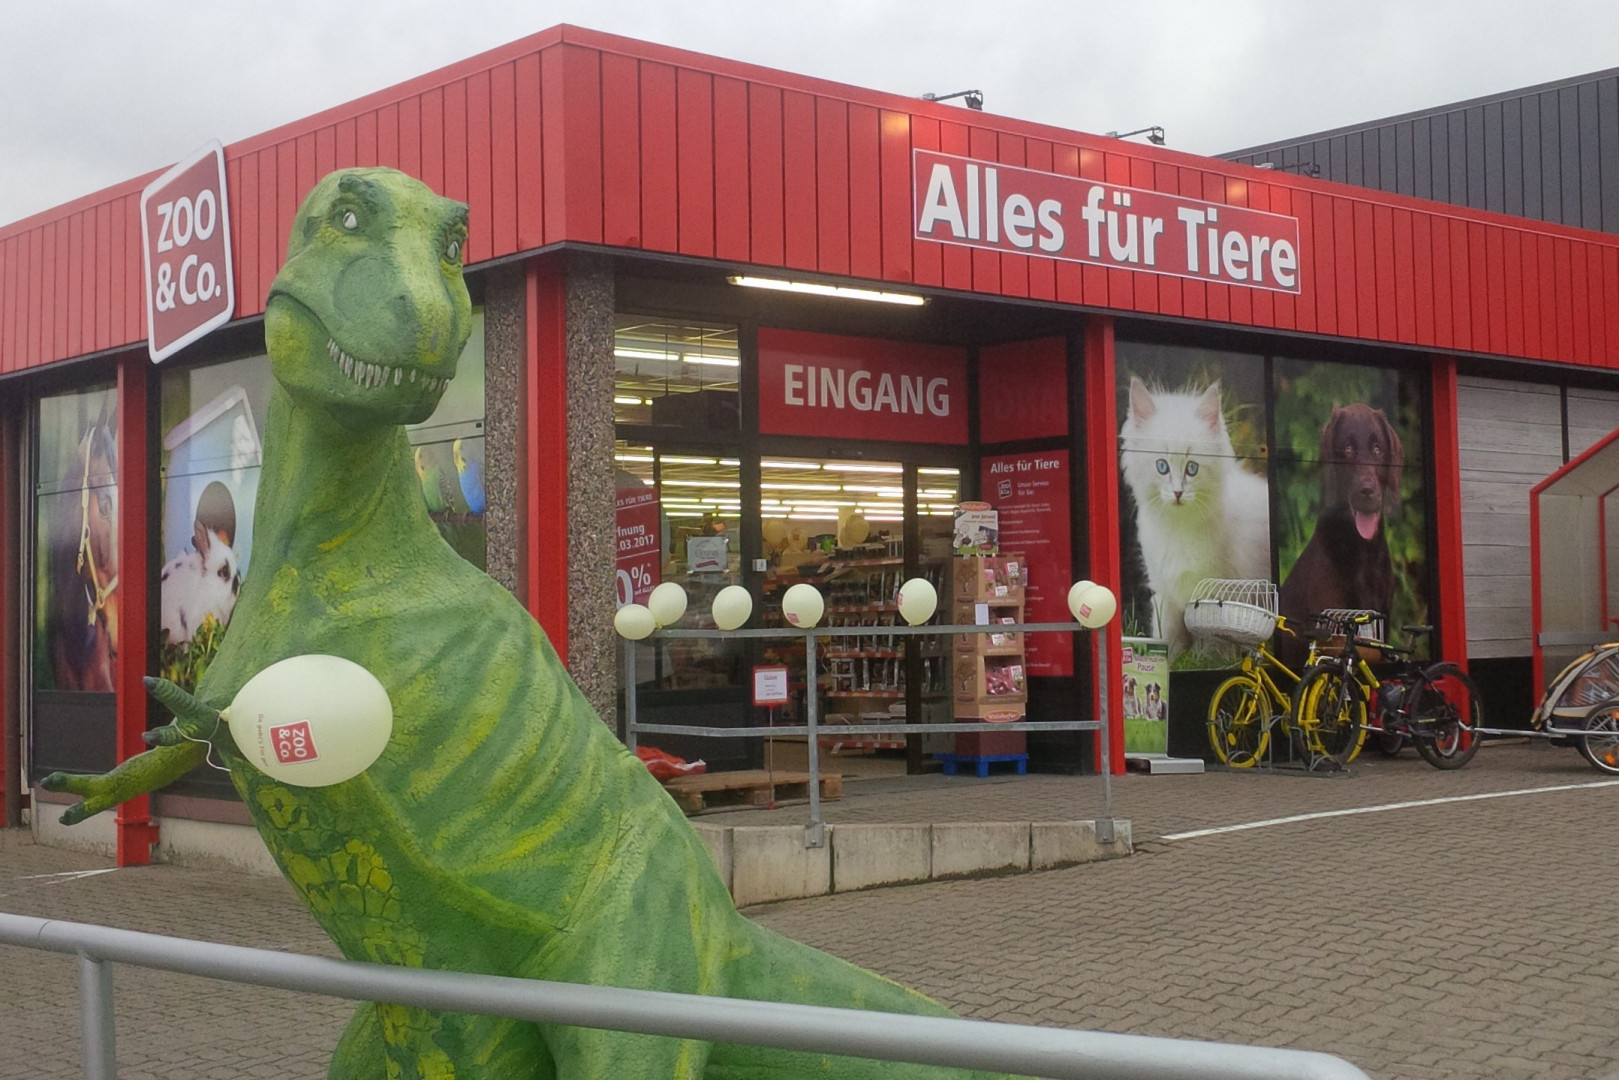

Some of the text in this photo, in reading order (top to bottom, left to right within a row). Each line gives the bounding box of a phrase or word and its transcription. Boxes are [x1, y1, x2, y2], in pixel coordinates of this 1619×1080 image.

[157, 189, 216, 253] ZOO
[918, 163, 1297, 287] Alles für Tiere
[784, 363, 949, 417] EINGANG
[990, 459, 1060, 474] Alles für Tiere
[617, 524, 645, 537] fnung
[293, 728, 307, 758] ZOO
